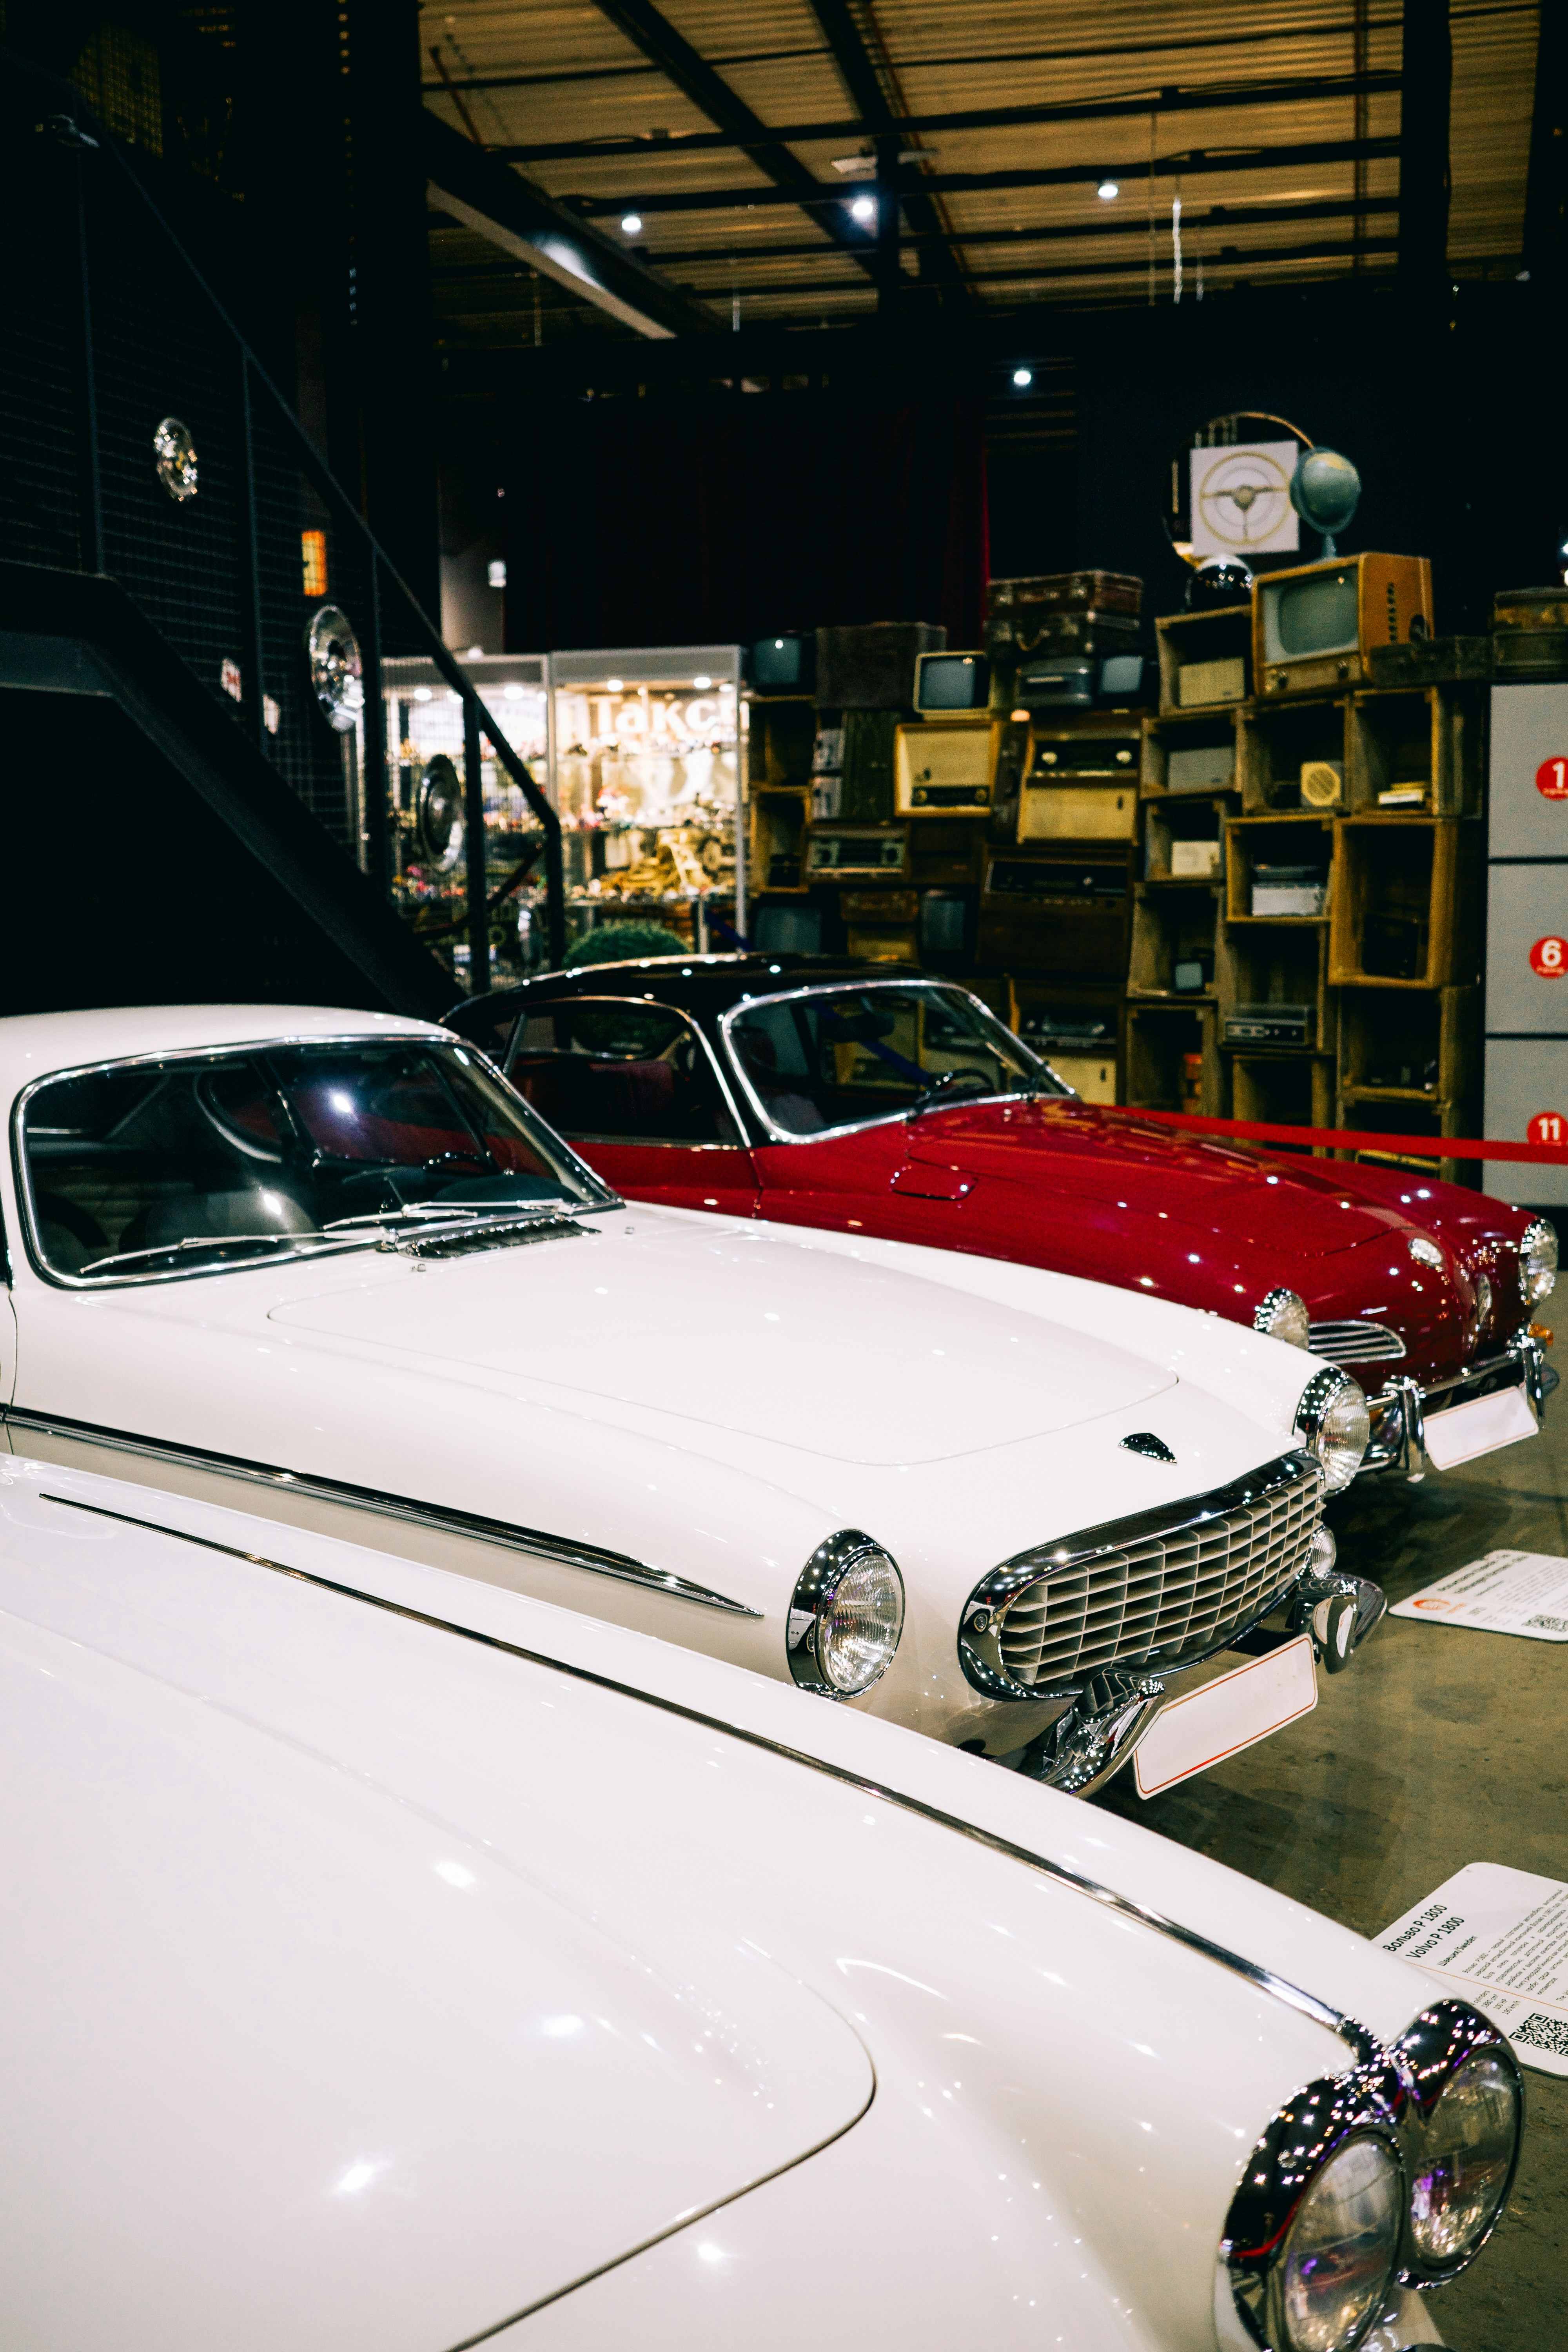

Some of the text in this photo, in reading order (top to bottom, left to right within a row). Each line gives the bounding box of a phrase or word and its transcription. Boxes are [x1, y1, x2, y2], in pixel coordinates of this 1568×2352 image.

[1552, 761, 1565, 789] 1
[1541, 940, 1562, 967] 6
[1537, 1117, 1560, 1141] 11
[1382, 1927, 1421, 1951] Вольво
[1421, 1905, 1447, 1921] 1800
[1405, 1940, 1437, 1958] Volvo
[1437, 1917, 1465, 1934] 1800
